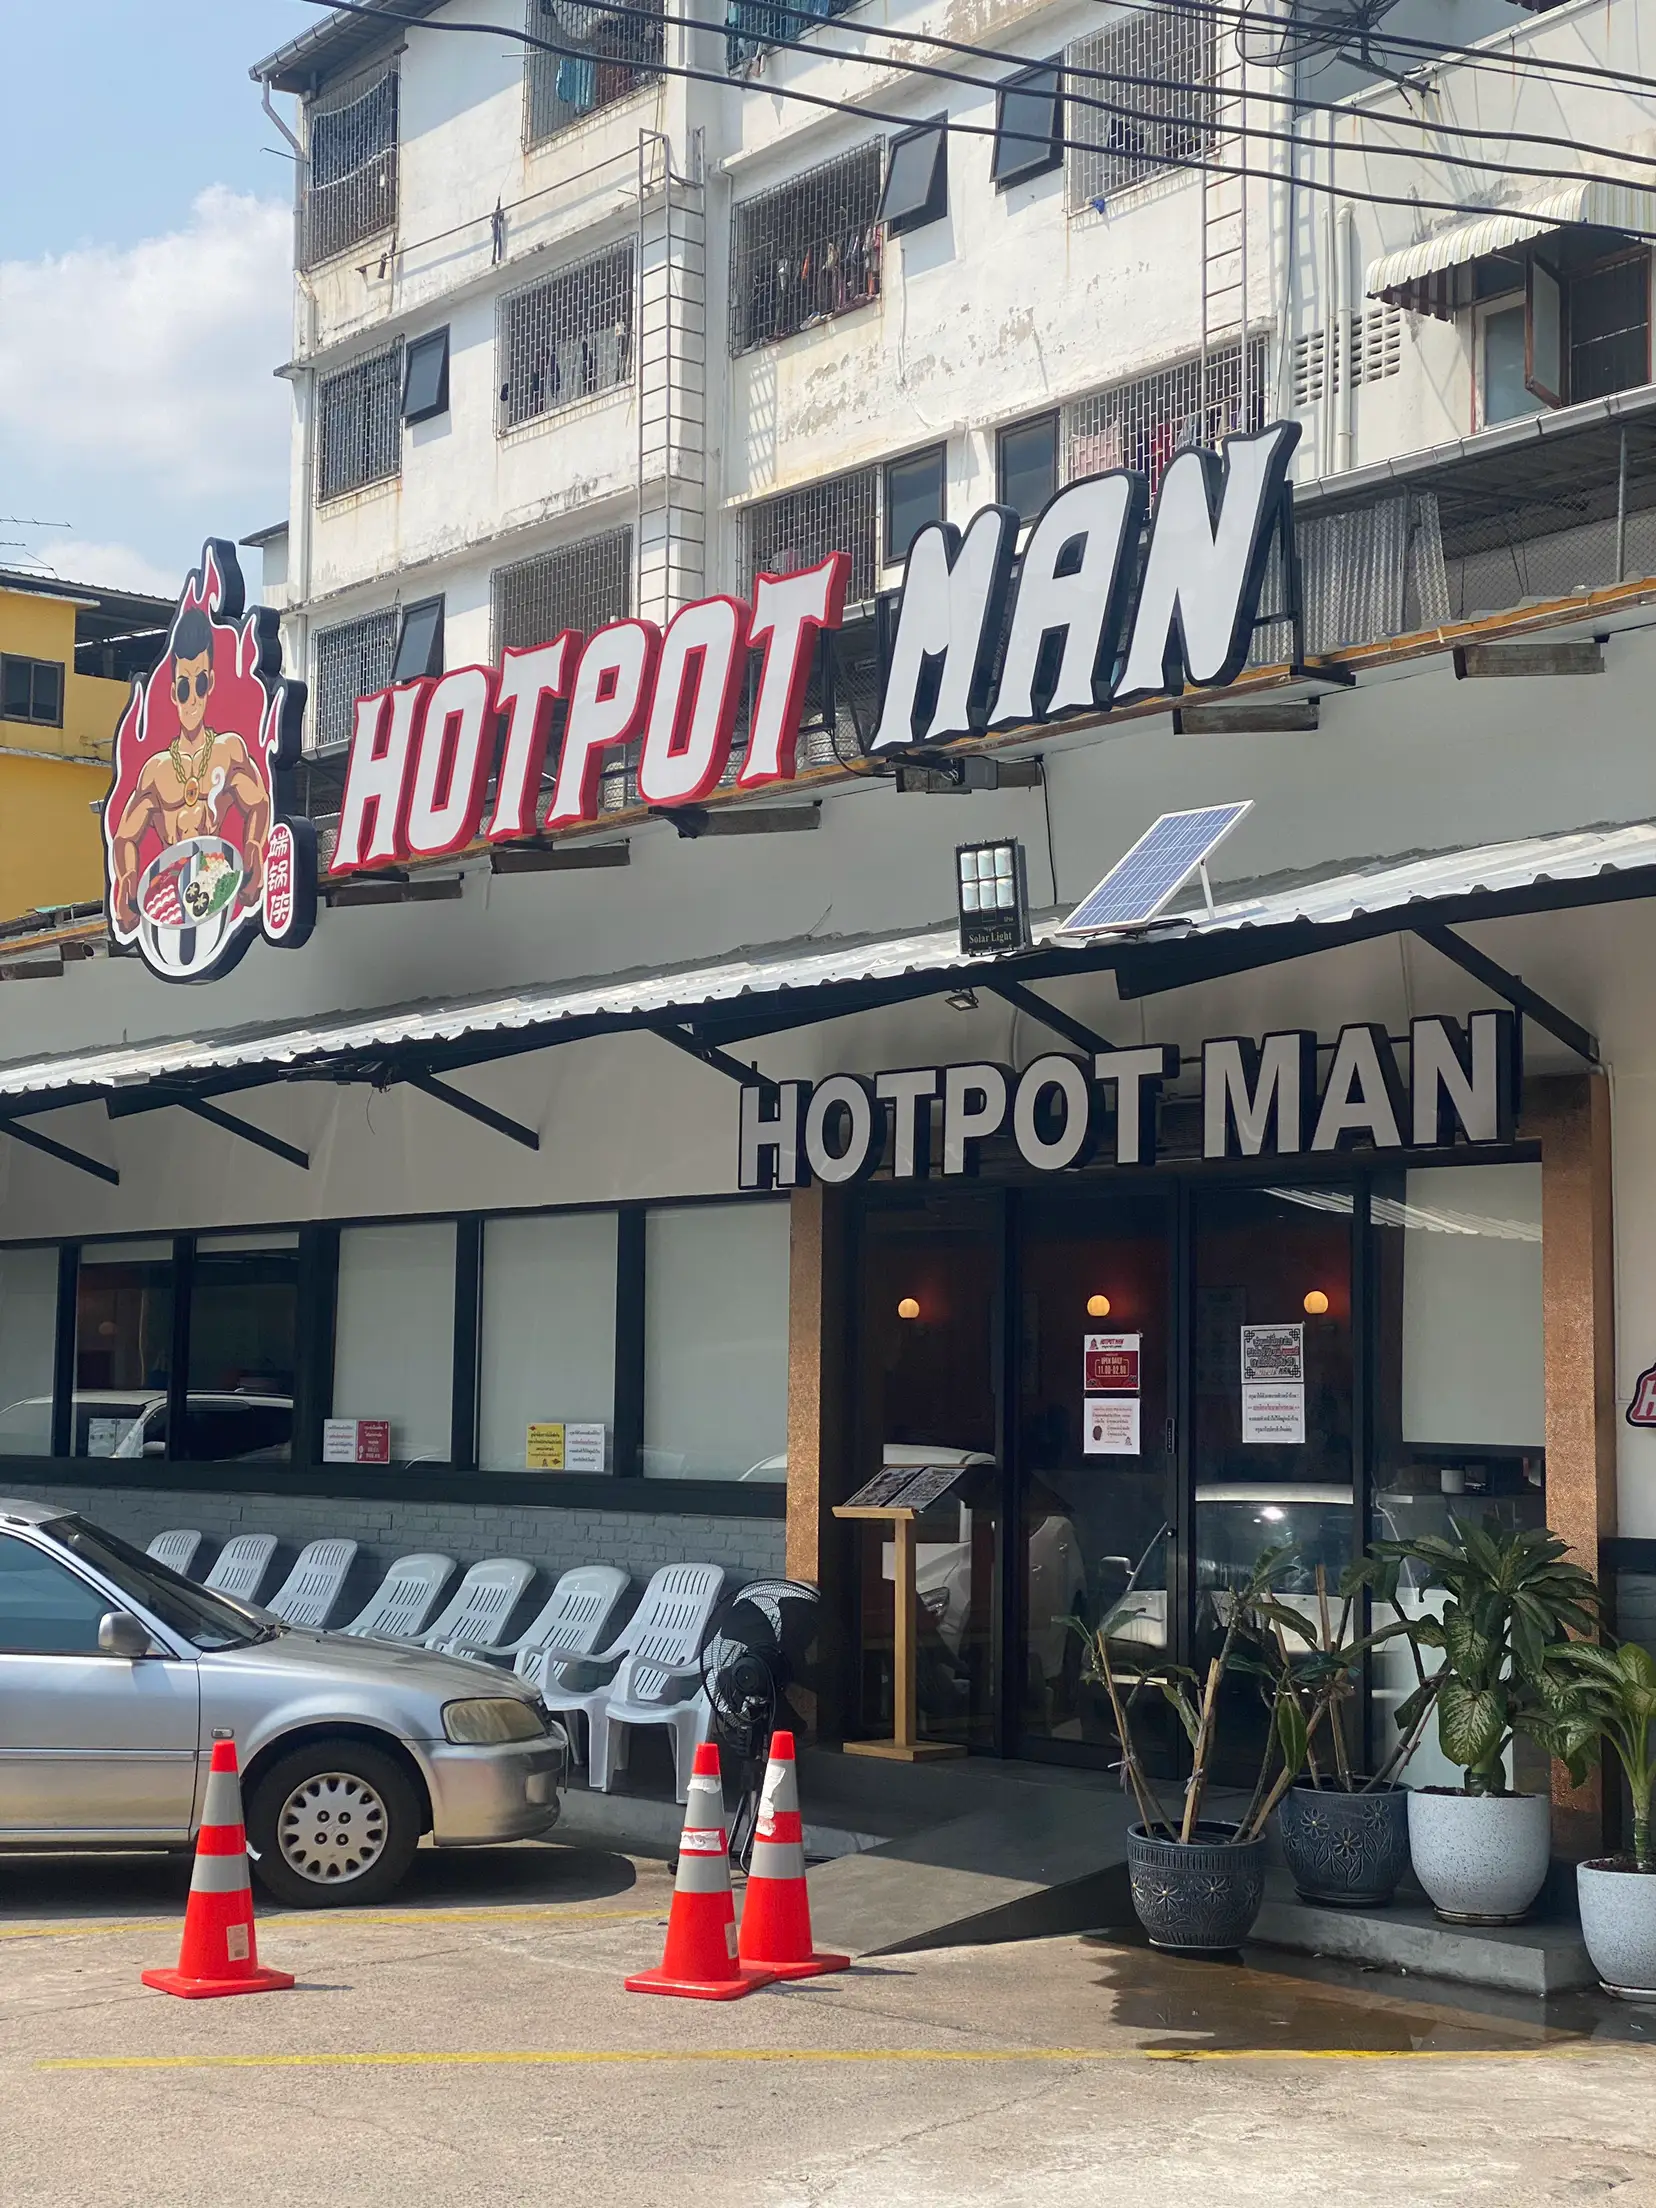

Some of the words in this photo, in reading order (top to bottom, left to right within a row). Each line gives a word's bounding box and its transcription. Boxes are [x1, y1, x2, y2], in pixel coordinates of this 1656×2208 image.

[330, 551, 850, 875] HOTPOT
[868, 421, 1300, 756] MAN
[268, 830, 290, 926] 端锅侠
[969, 933, 989, 944] Solar
[991, 931, 1012, 944] Light
[739, 1045, 1172, 1189] HOTPOT
[1202, 1011, 1505, 1159] MAN
